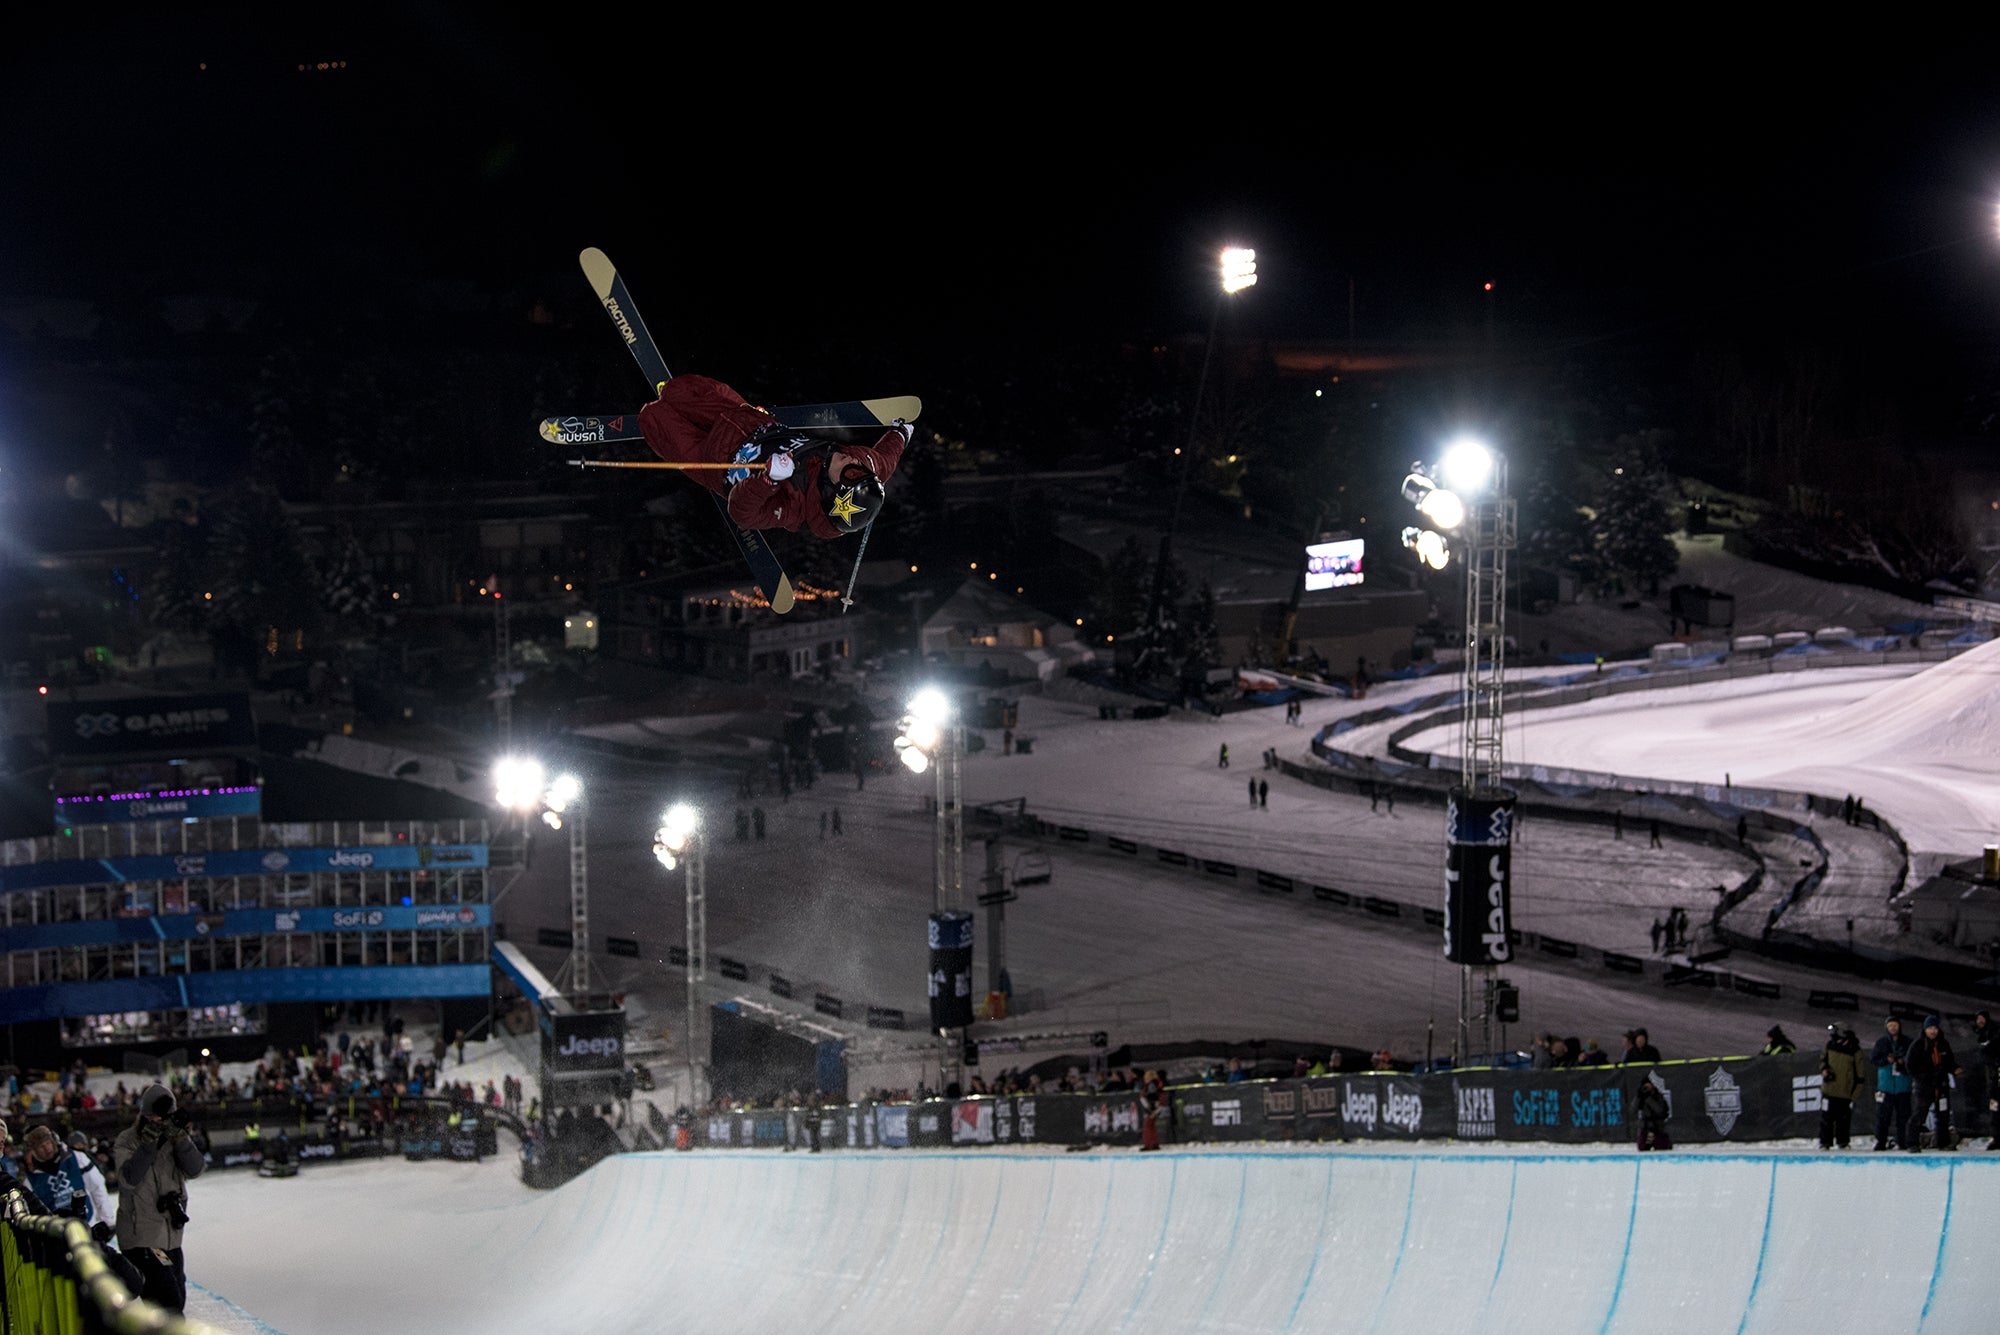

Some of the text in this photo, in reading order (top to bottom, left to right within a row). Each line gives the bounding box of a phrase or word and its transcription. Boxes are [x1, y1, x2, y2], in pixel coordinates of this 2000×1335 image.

[607, 296, 638, 345] FACTION
[328, 850, 373, 868] Jeep
[1481, 853, 1510, 962] Jeep
[559, 1034, 618, 1057] Jeep
[1341, 1082, 1377, 1132] Jeep
[1382, 1083, 1422, 1133] Jeep
[1458, 1088, 1495, 1121] ASPEN
[1512, 1089, 1544, 1126] SoFi
[1570, 1089, 1605, 1127] SoFi
